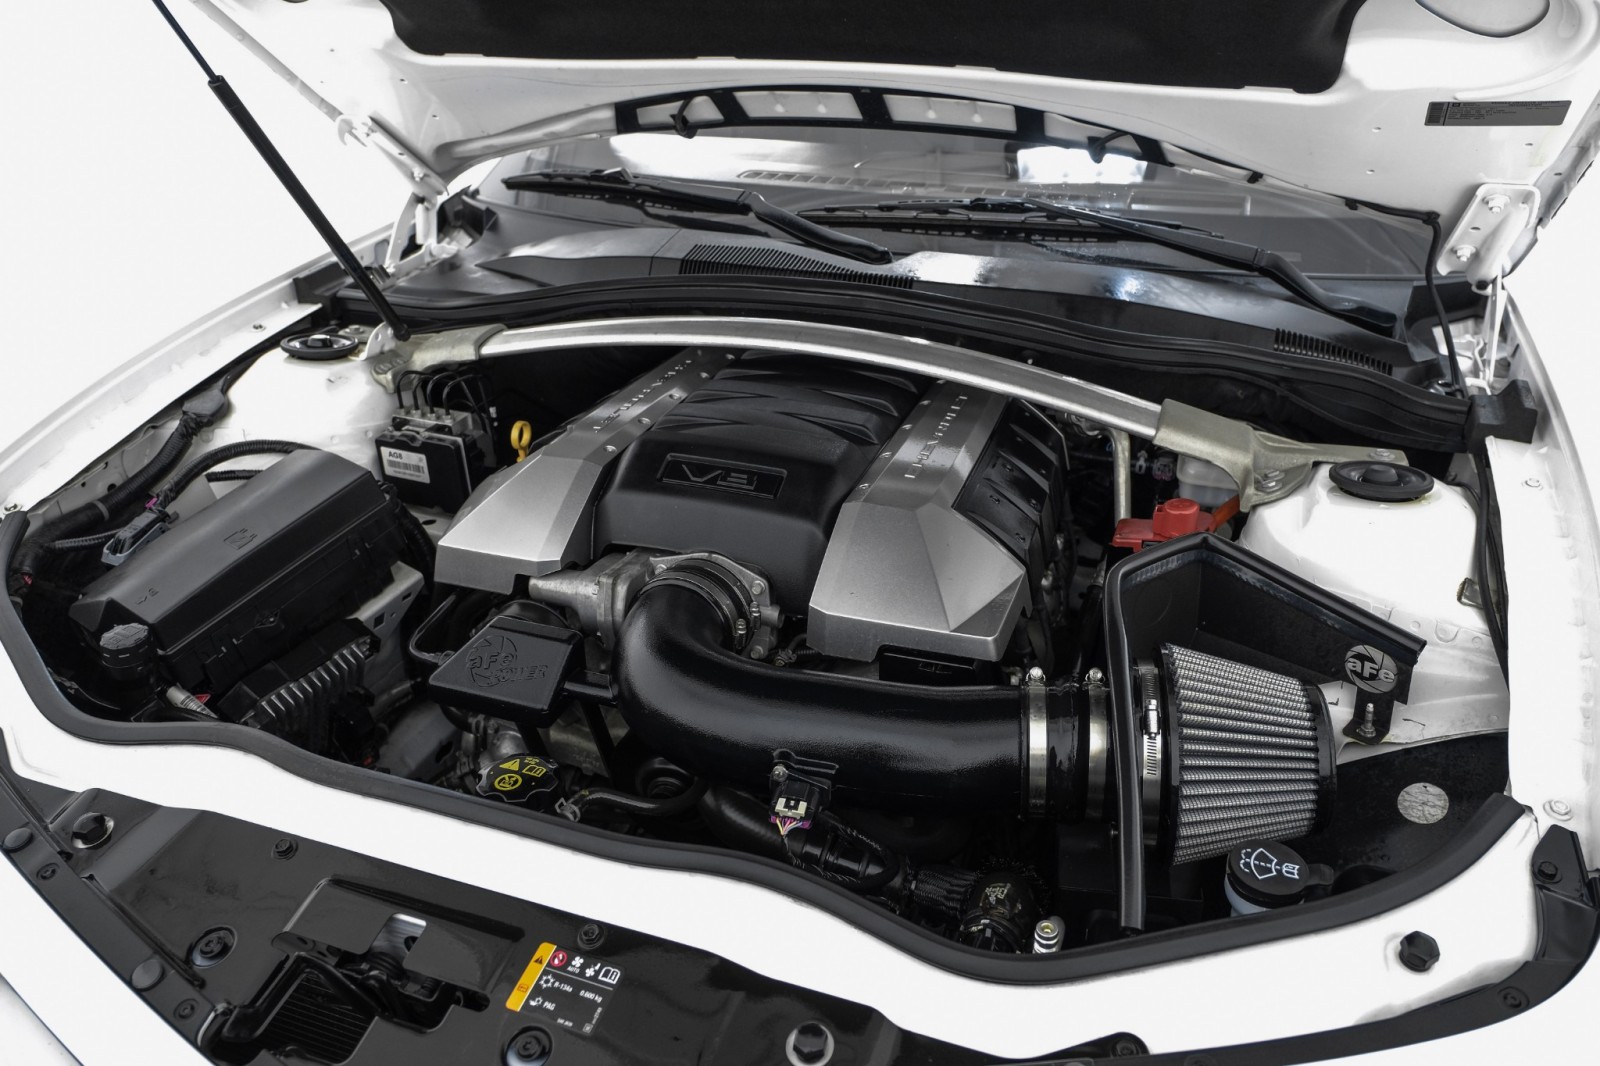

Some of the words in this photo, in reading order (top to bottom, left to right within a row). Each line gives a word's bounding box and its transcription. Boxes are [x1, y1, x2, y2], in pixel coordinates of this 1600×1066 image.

[682, 463, 758, 490] V8
[1347, 657, 1395, 683] aFe
[567, 966, 581, 974] AUTO
[553, 981, 573, 992] R-134a
[594, 995, 603, 1004] kg
[543, 1001, 556, 1011] PAG
